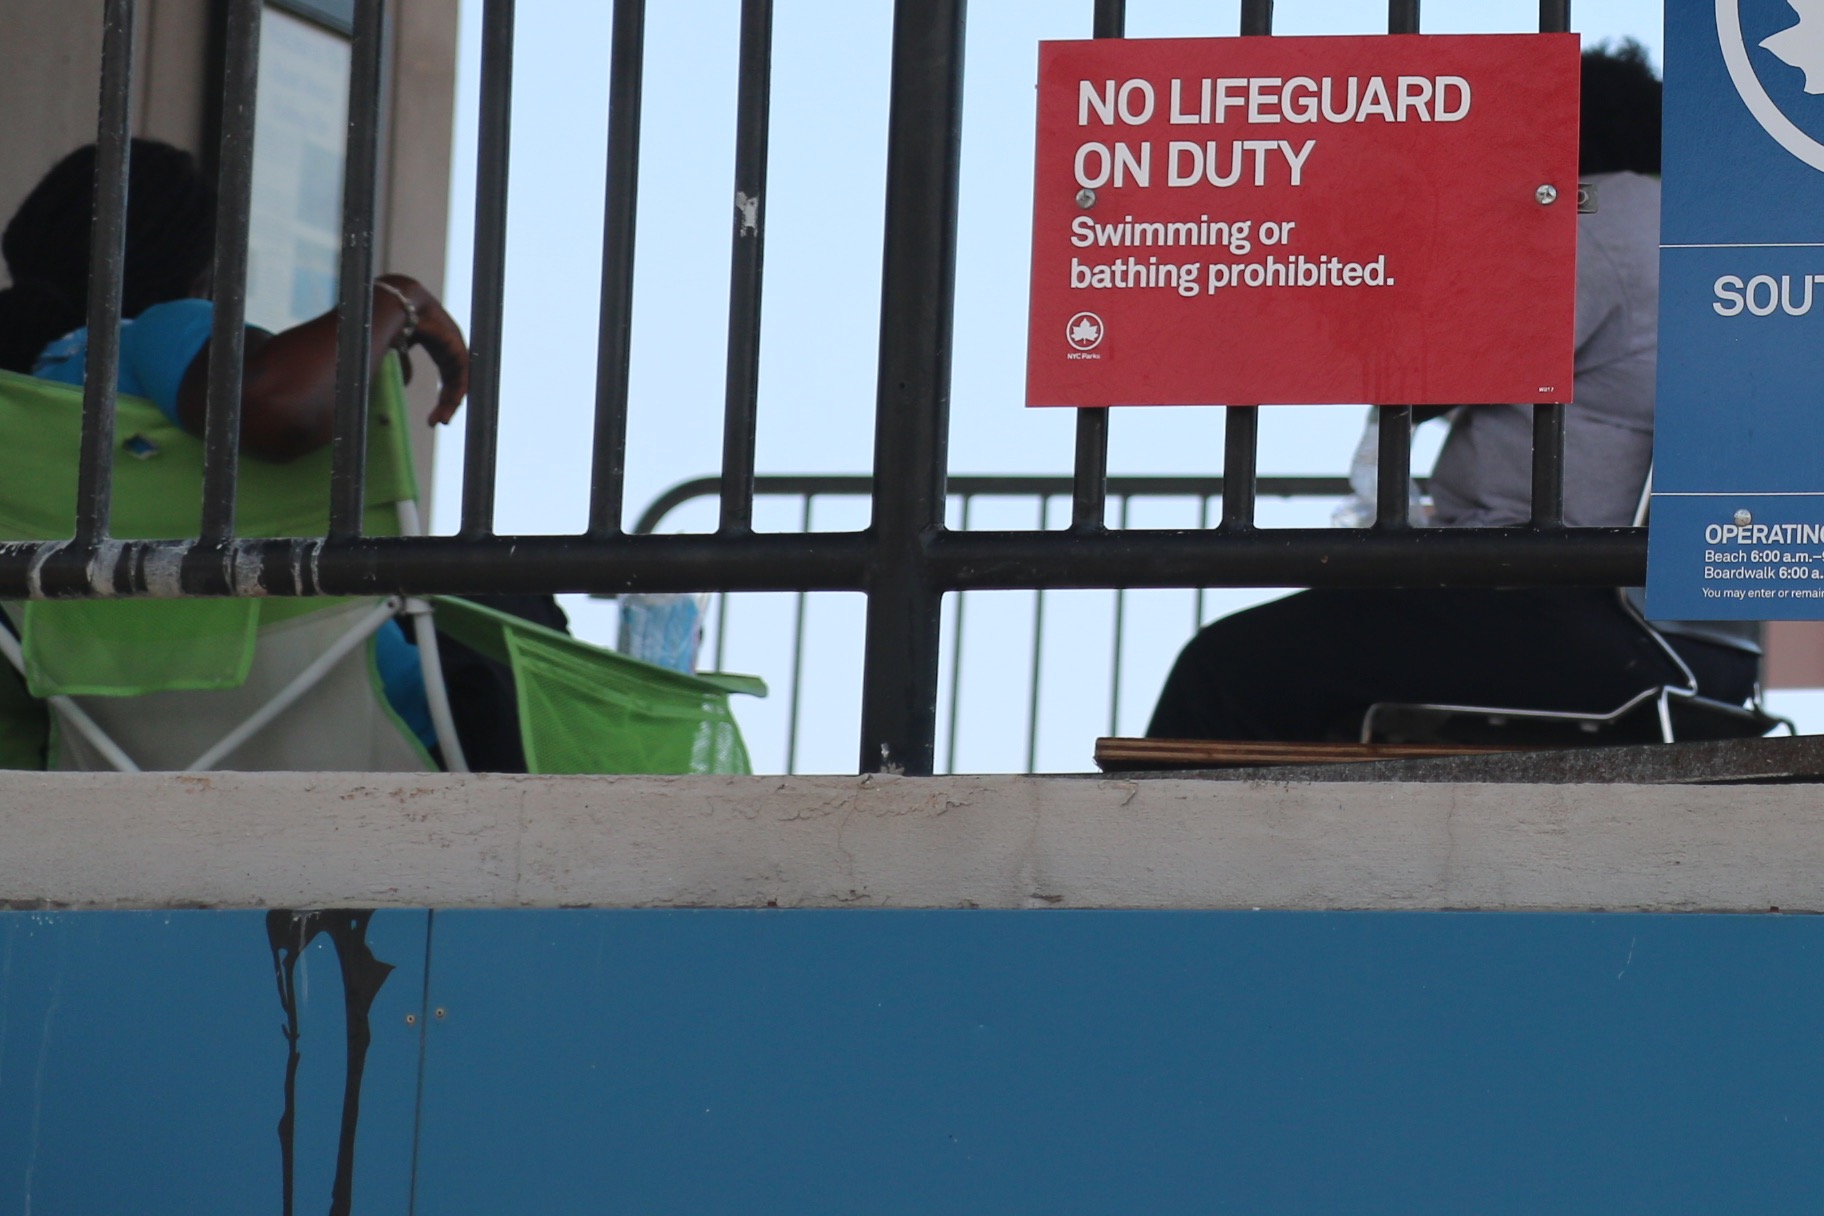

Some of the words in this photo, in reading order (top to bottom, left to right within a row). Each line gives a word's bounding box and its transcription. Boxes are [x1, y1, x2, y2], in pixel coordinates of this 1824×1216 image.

[1078, 78, 1154, 124] NO
[1169, 76, 1471, 123] LIFEGUARD
[1073, 141, 1150, 187] ON
[1167, 140, 1315, 186] DUTY
[1070, 212, 1251, 253] Swimming
[1258, 222, 1295, 245] or
[1070, 254, 1200, 295] bathing
[1208, 253, 1394, 294] prohibited.
[1704, 546, 1747, 562] Beach
[1750, 546, 1780, 562] 6:00
[1704, 563, 1775, 578] Boardwalk
[1778, 563, 1808, 578] 6:00
[1701, 586, 1721, 597] You
[1723, 589, 1746, 600] may
[1747, 587, 1776, 597] enter
[1777, 589, 1789, 597] or
